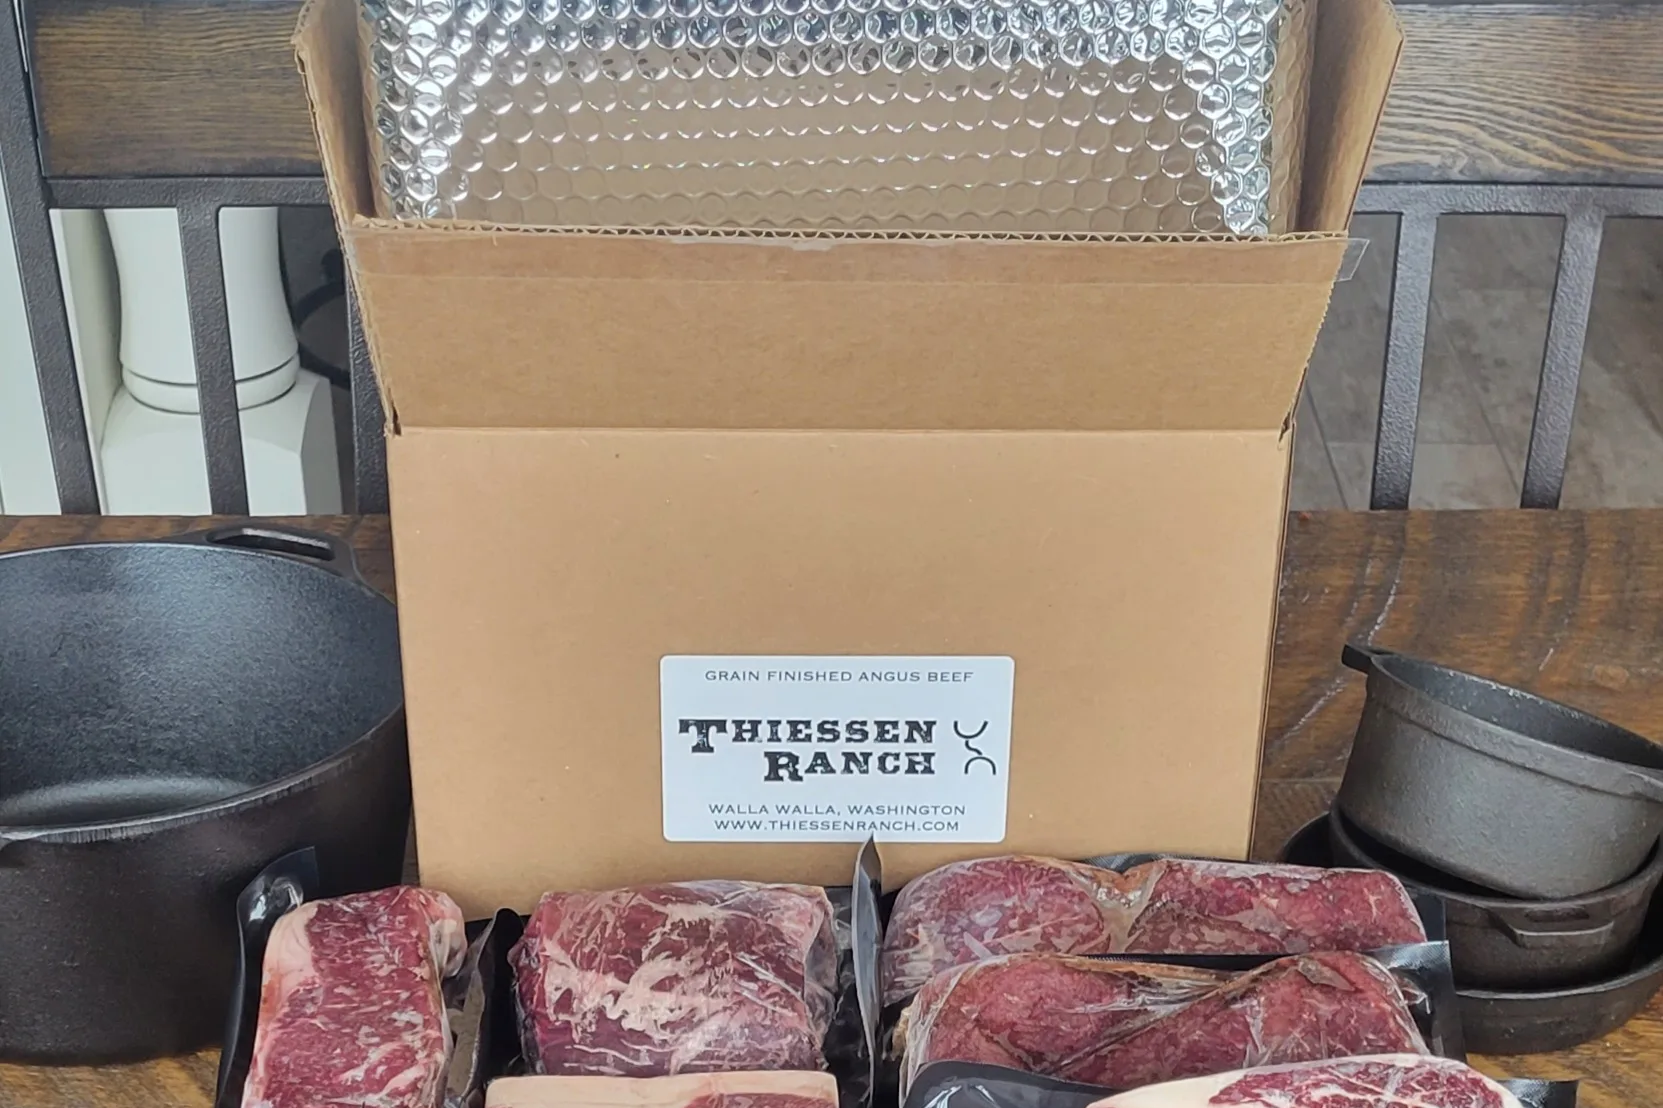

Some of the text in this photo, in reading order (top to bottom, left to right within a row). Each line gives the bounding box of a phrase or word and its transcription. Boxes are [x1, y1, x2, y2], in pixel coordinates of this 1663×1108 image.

[705, 671, 974, 682] GRAIN FINISHED ANGUS BEEF
[678, 718, 937, 753] THIESSEN
[763, 751, 936, 782] RANCH
[709, 804, 966, 816] WALLA WALLA, WASHINGTON
[714, 820, 959, 831] WWW.THIESSENRANCH.COM
